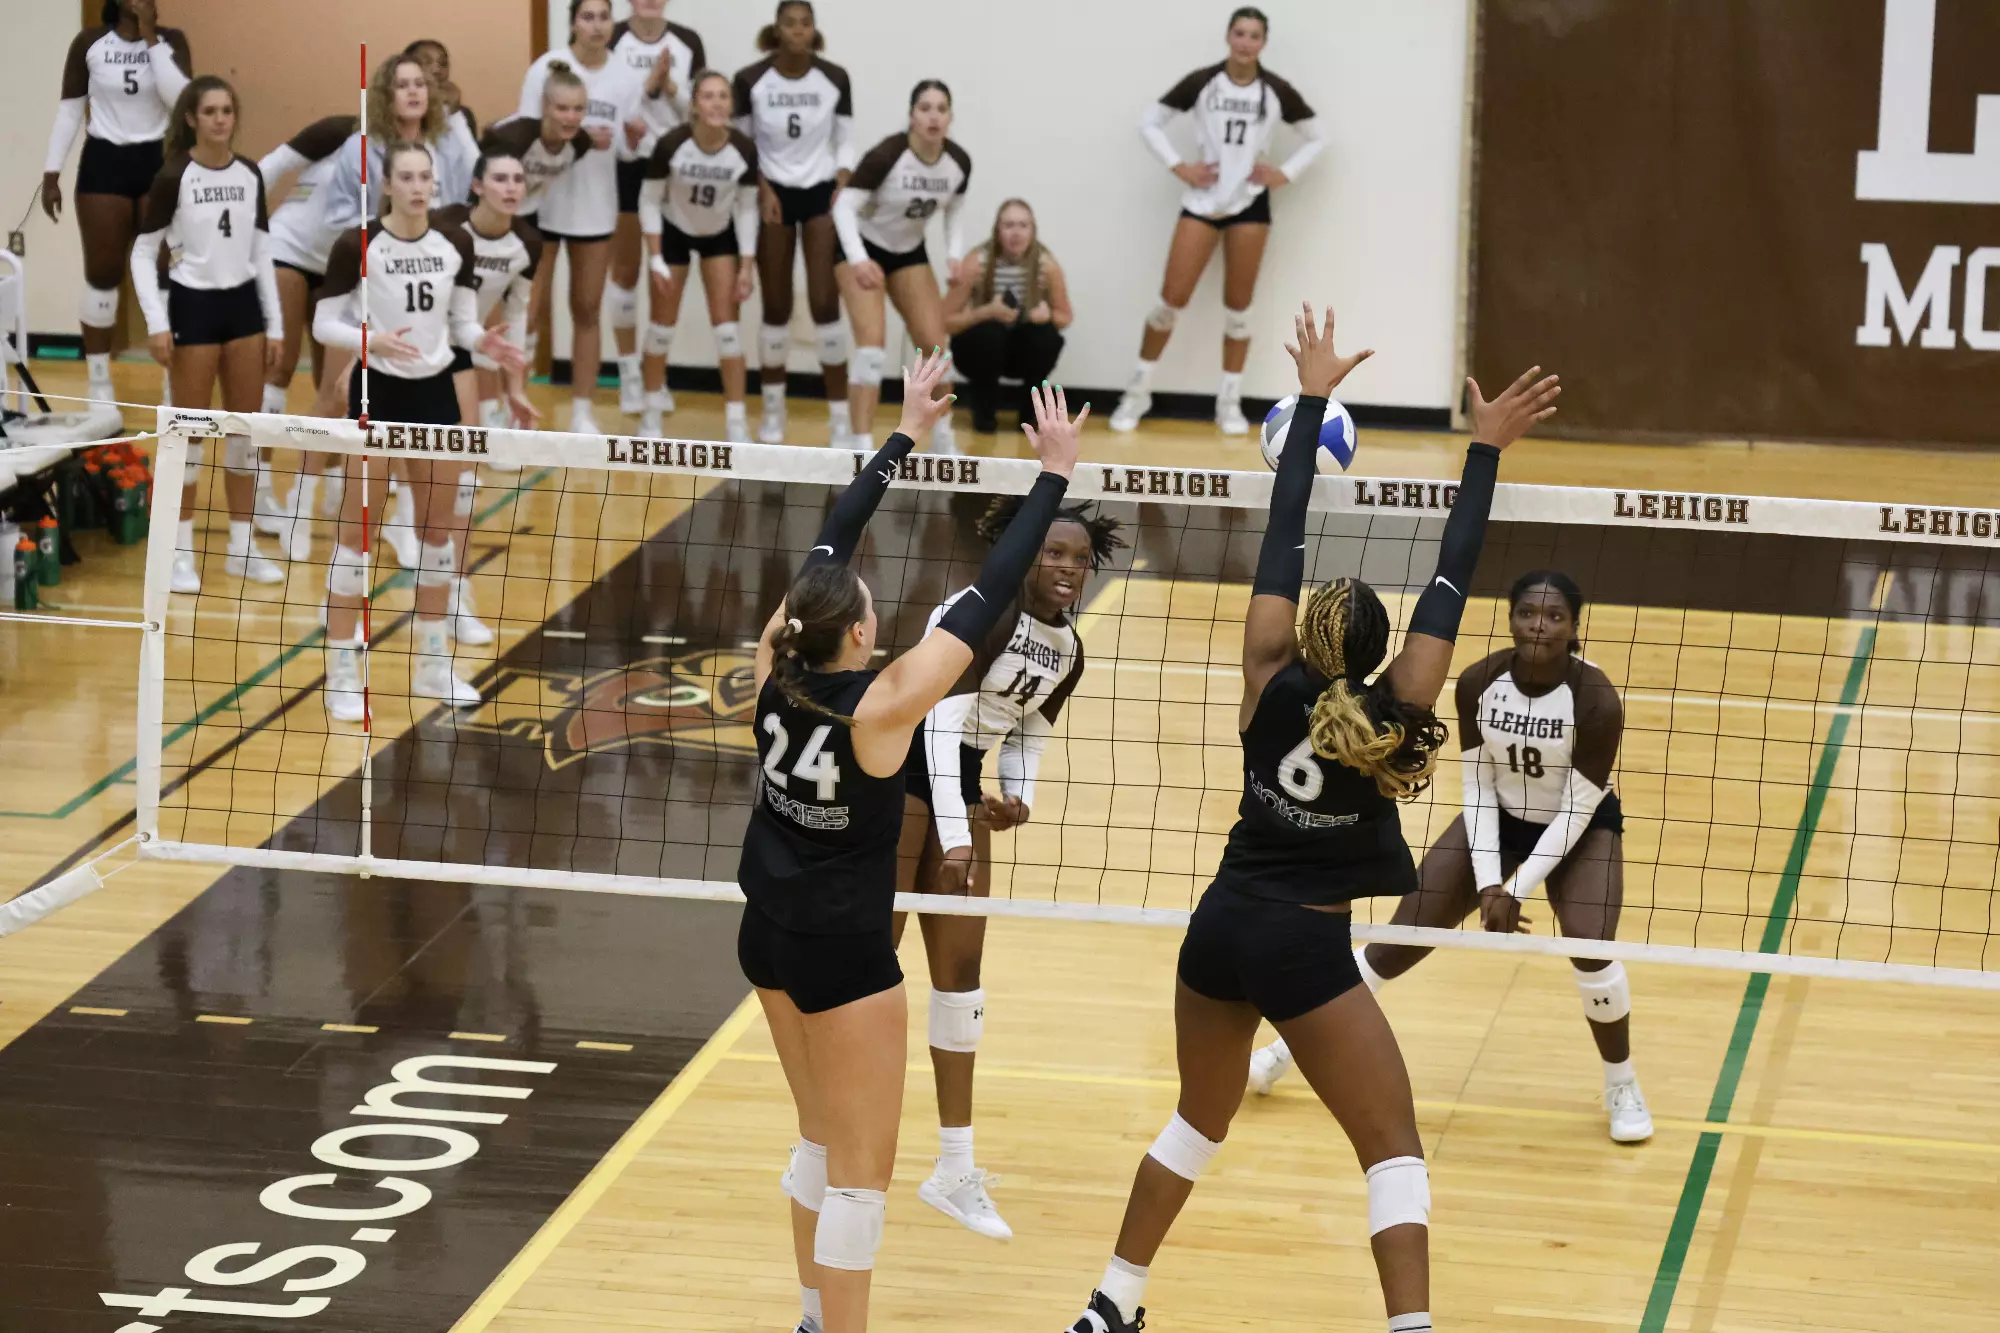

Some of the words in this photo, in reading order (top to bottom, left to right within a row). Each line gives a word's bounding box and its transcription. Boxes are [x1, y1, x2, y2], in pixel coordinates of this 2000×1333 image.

[123, 69, 139, 96] 5
[788, 112, 802, 139] 6
[1224, 120, 1247, 145] 17
[192, 186, 245, 205] LEHIGH
[689, 183, 716, 208] 19
[904, 197, 938, 219] 20
[217, 208, 232, 238] 4
[384, 256, 444, 275] LEHIGH
[404, 280, 434, 312] 16
[363, 423, 490, 455] LEHIGH
[606, 437, 734, 471] LEHIGH
[853, 452, 980, 484] LHIGH
[1101, 467, 1232, 499] LEHIGH
[1355, 479, 1461, 510] LEHIG
[1614, 491, 1750, 525] LEHIGH
[1006, 633, 1061, 673] LEHIGH
[996, 667, 1045, 707] 14
[1488, 707, 1564, 739] LEHIGH
[762, 712, 840, 801] 24
[1277, 735, 1324, 803] 6
[1506, 743, 1545, 779] 18
